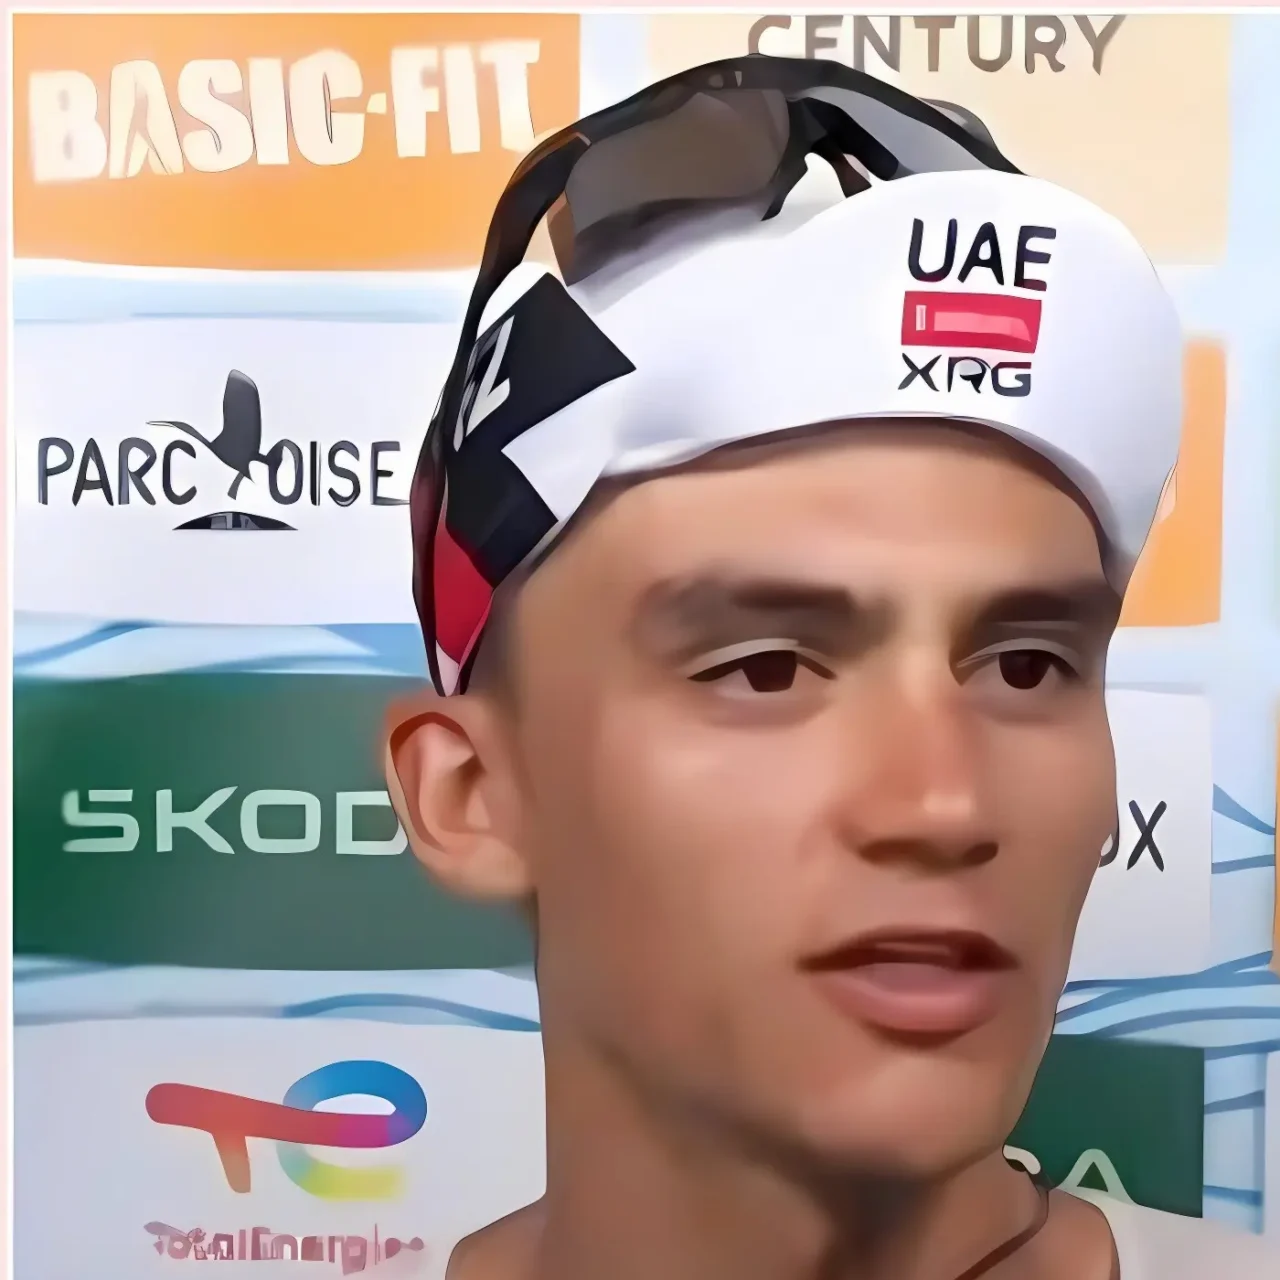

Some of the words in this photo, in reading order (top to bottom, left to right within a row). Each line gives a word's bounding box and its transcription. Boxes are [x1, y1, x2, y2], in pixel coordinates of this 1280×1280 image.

[748, 14, 1127, 75] CENTURY
[908, 217, 1057, 292] UAE
[898, 352, 1032, 397] XRG
[38, 437, 198, 506] PARC
[275, 440, 402, 507] OISE
